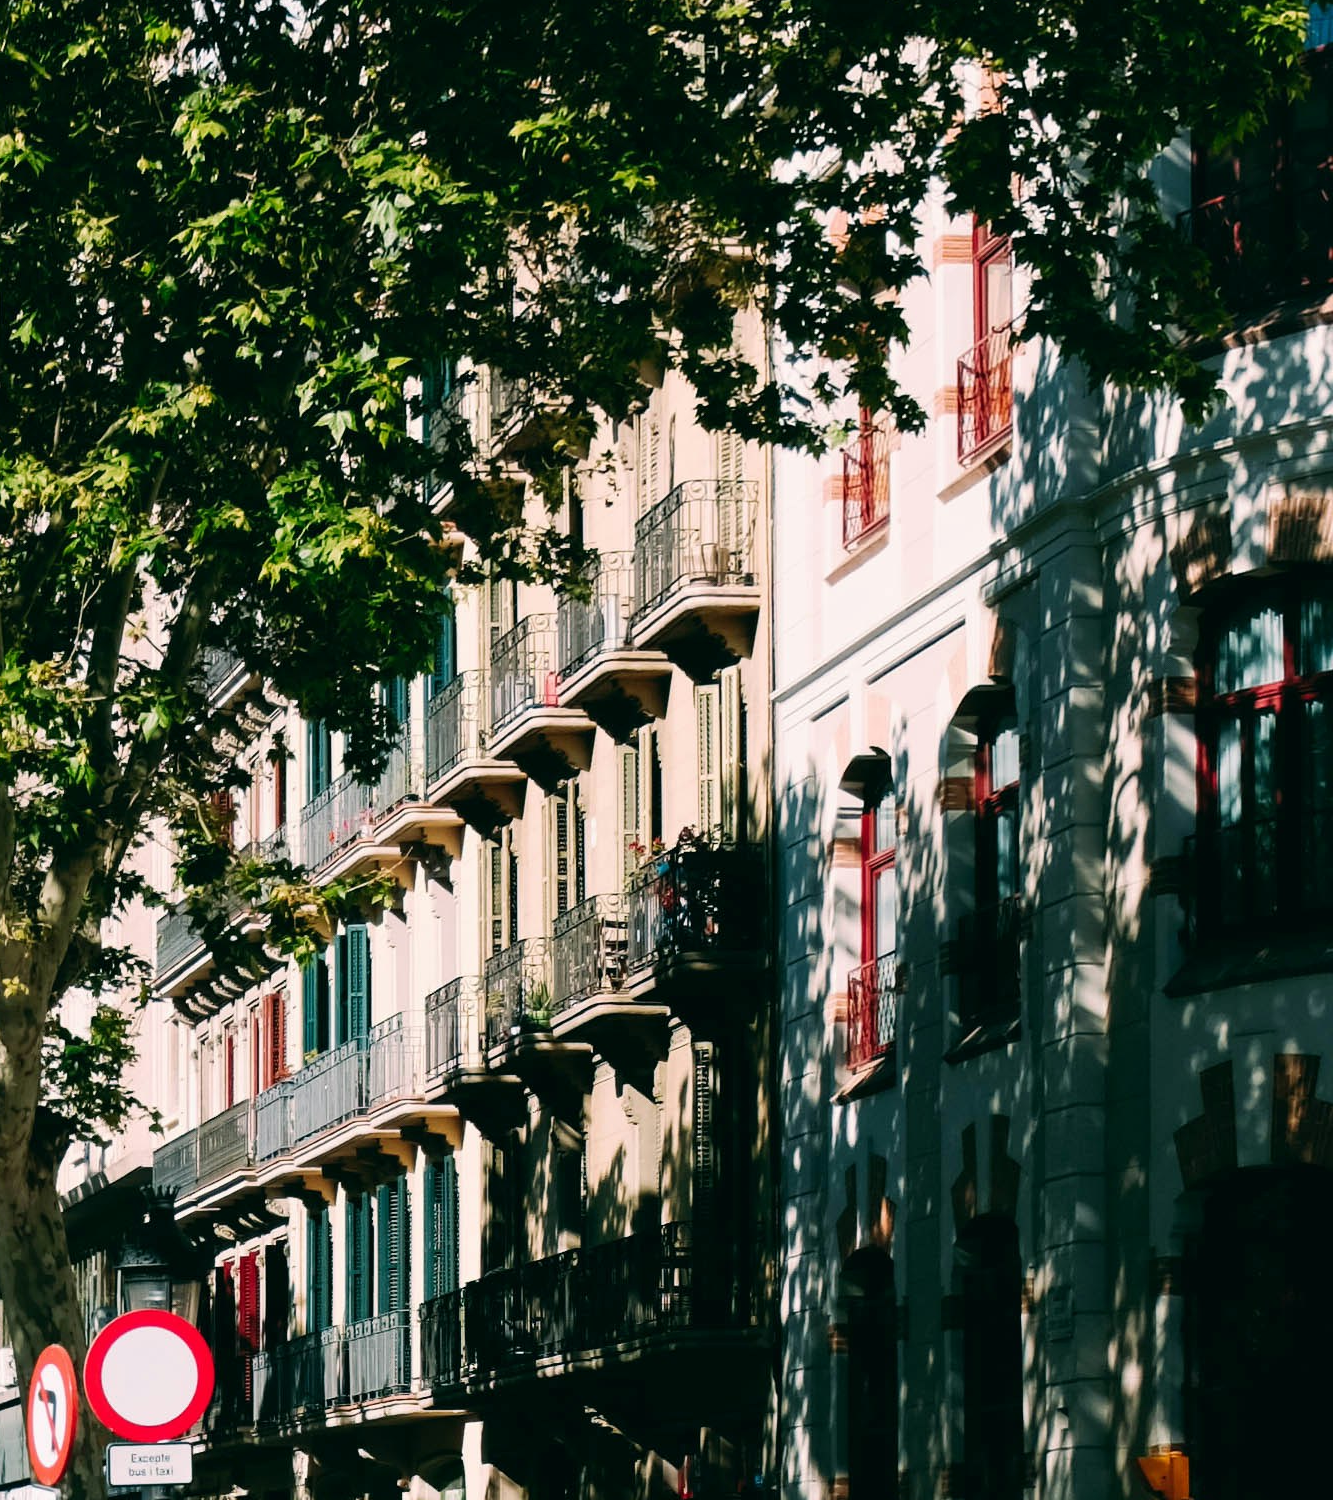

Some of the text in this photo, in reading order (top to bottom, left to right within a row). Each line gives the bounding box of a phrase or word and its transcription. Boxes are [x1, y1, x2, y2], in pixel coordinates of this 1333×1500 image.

[131, 1453, 171, 1464] Excepte
[128, 1467, 147, 1477] bus
[156, 1466, 174, 1476] taxi
